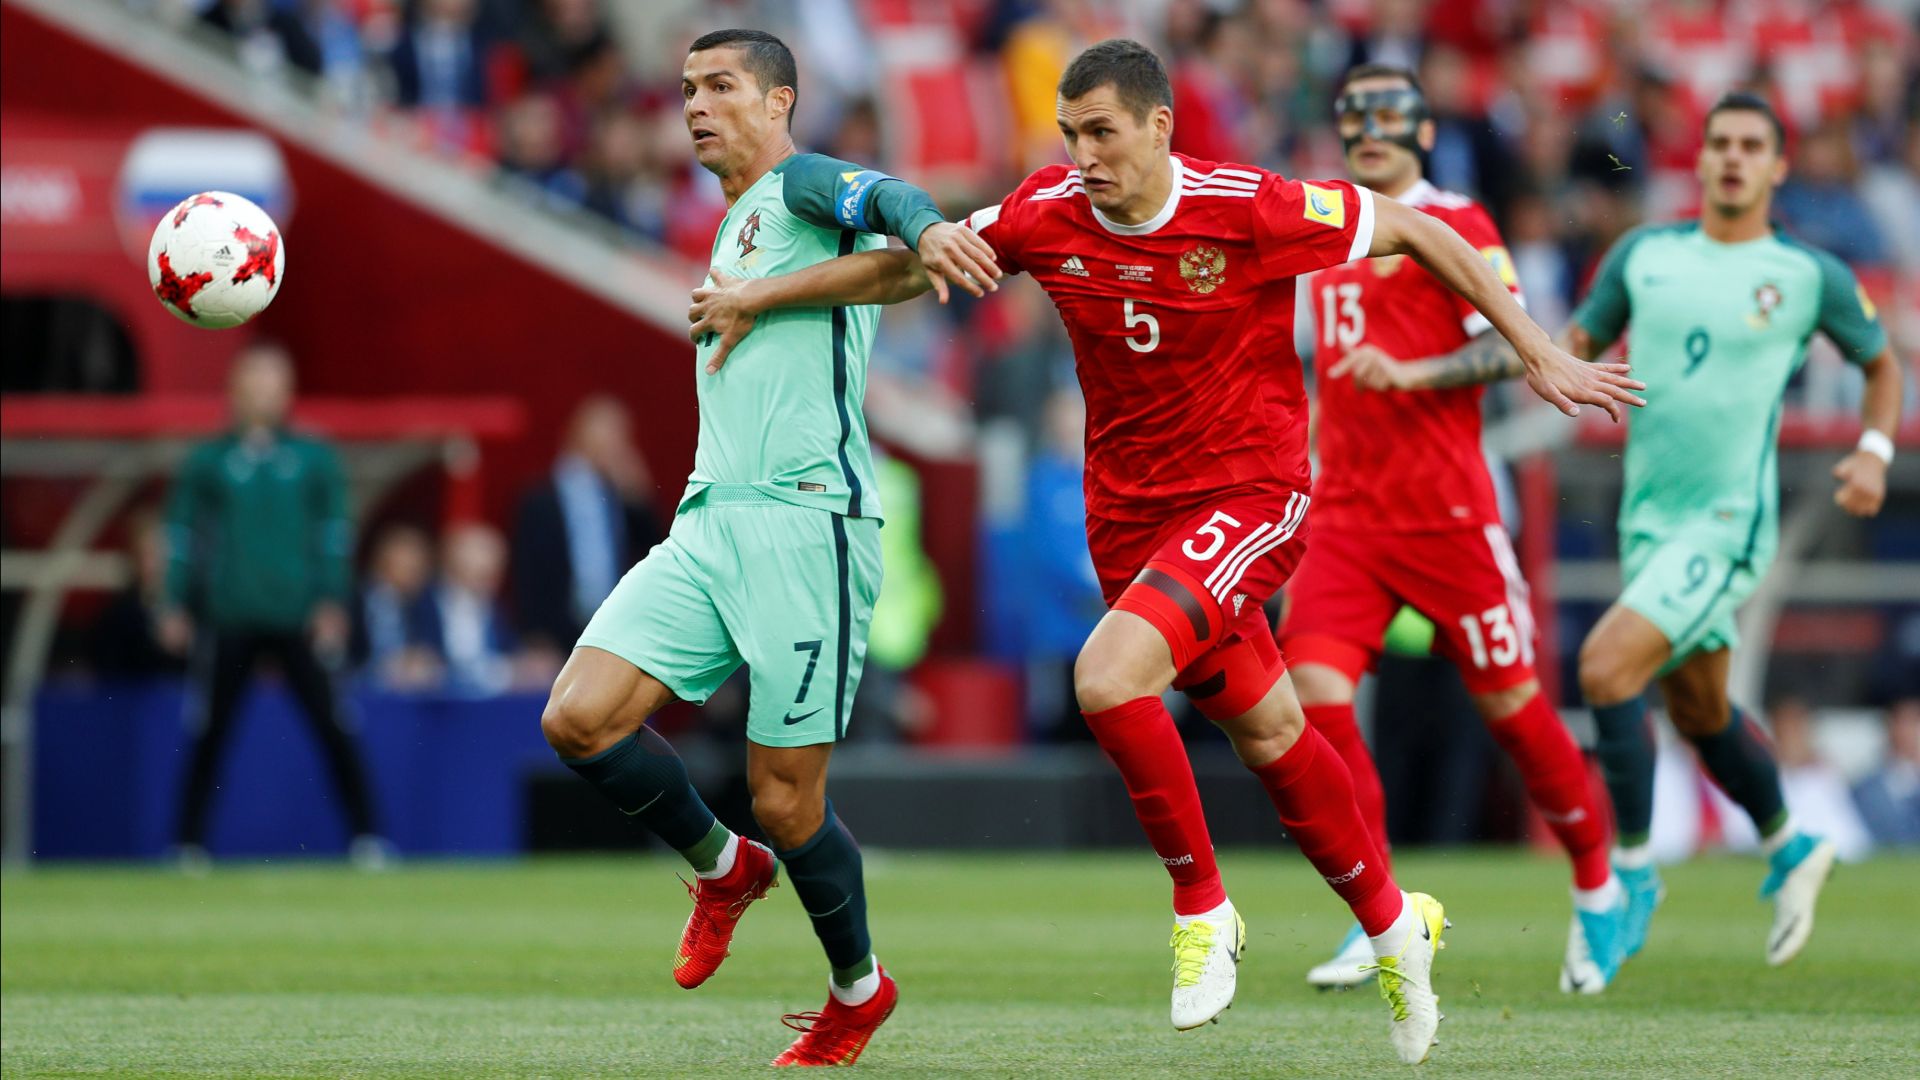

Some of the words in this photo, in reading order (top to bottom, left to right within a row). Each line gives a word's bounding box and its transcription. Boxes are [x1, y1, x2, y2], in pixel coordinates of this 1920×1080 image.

[1123, 298, 1160, 353] 5
[1321, 283, 1366, 349] 13
[1683, 327, 1711, 379] 9
[1181, 510, 1242, 561] 5
[1680, 554, 1710, 597] 9
[1459, 604, 1519, 669] 13
[794, 640, 823, 703] 7
